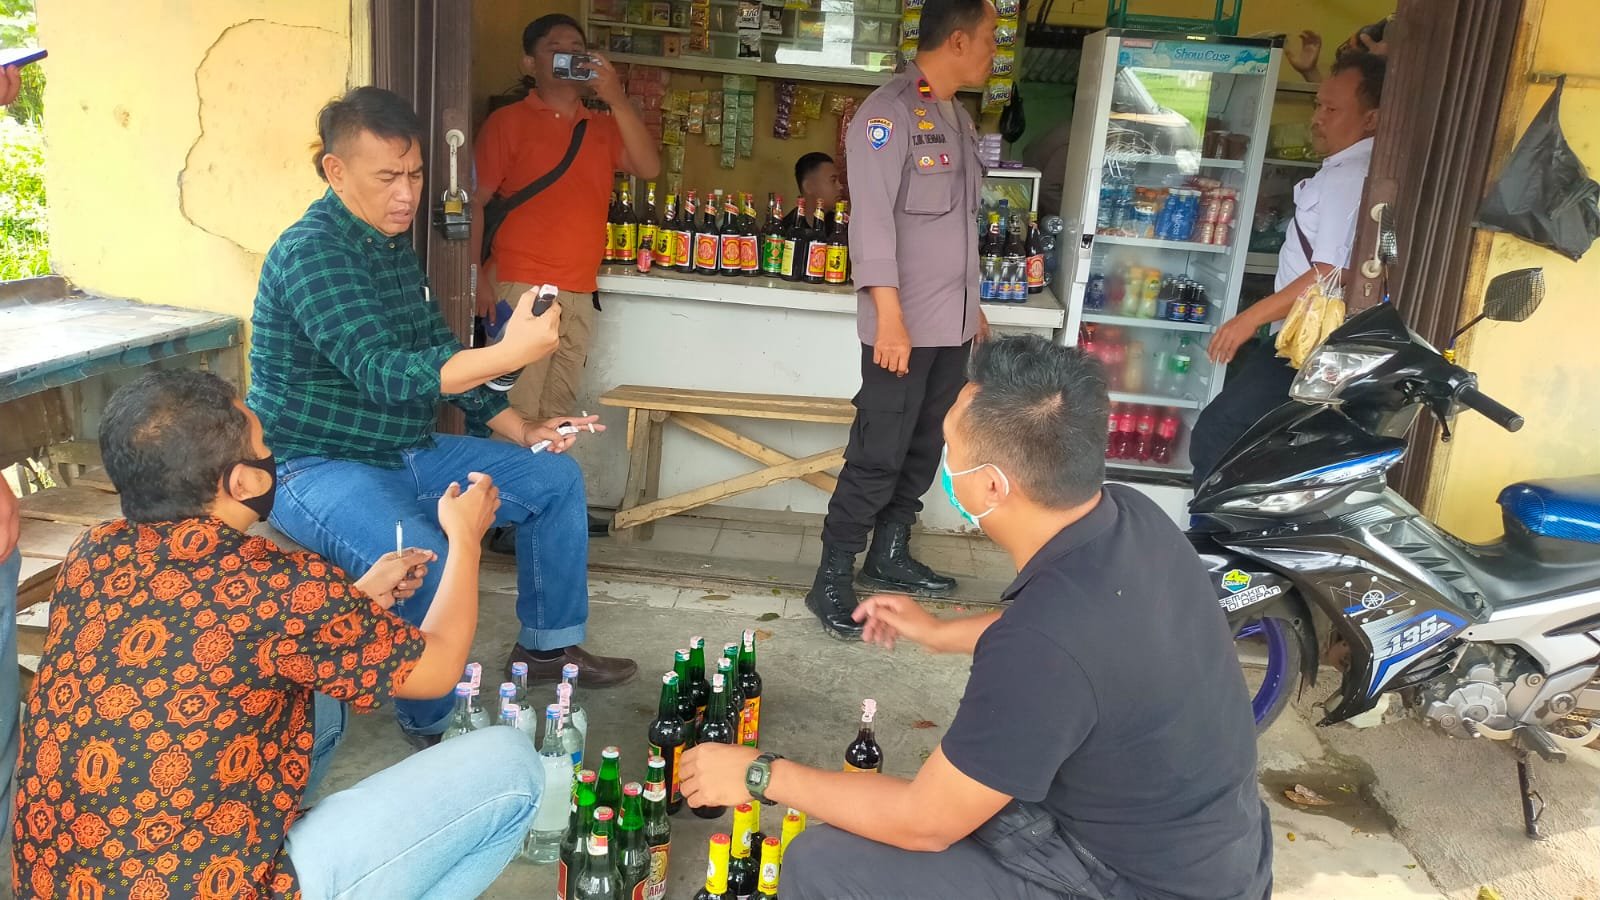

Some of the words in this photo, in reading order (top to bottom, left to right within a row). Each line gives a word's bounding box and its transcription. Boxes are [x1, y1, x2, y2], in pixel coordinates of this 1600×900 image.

[1219, 585, 1266, 606] SEMAKIN
[1228, 602, 1240, 611] DI
[1241, 586, 1280, 606] DEPAN
